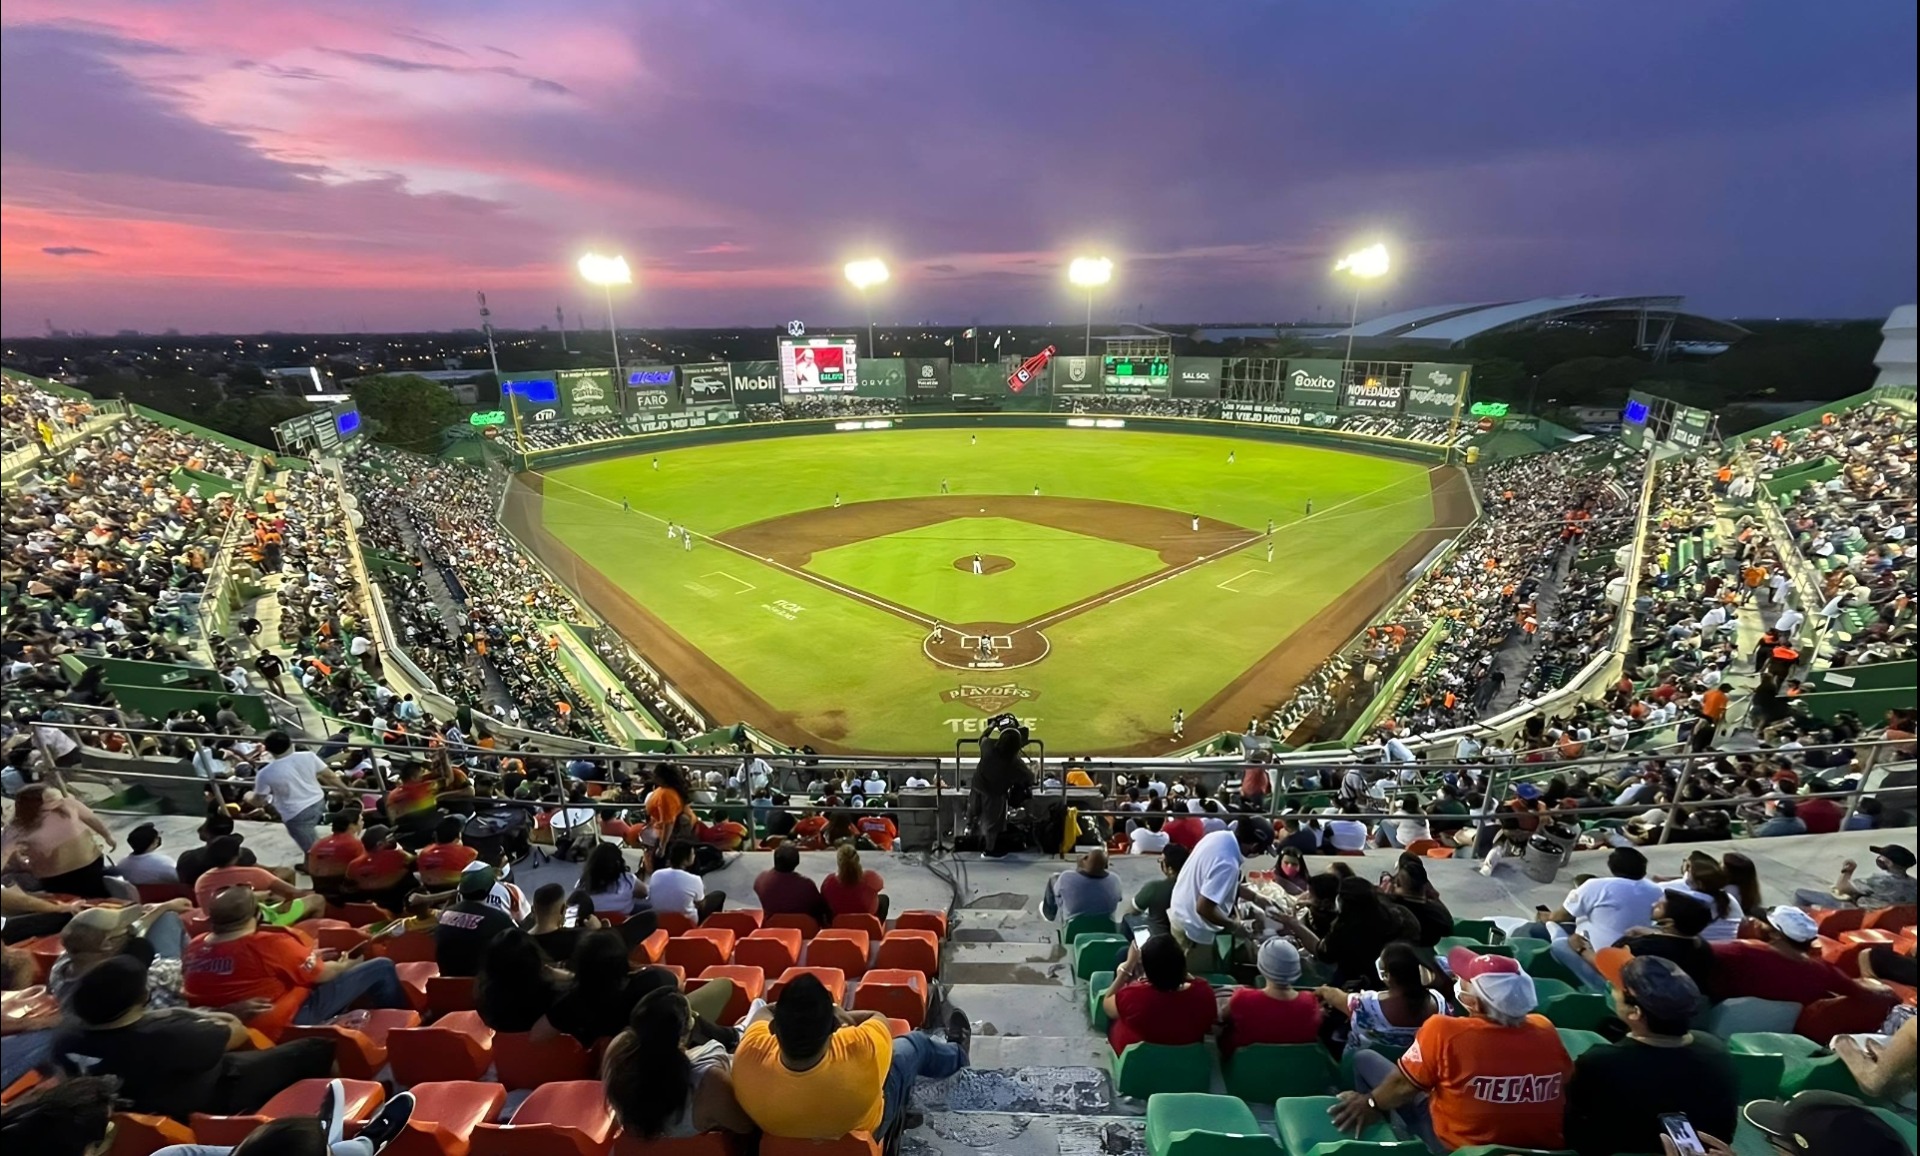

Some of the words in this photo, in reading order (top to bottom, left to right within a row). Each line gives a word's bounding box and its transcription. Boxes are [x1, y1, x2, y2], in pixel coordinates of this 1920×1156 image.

[734, 376, 776, 391] Mobil
[1294, 375, 1336, 389] Boxito
[1347, 385, 1401, 398] NOVEDADES
[637, 394, 668, 406] FARO
[1378, 400, 1397, 408] GAS
[1221, 411, 1234, 419] MI
[1236, 412, 1262, 421] VIEJO
[1263, 413, 1300, 425] MOLINO
[641, 420, 669, 432] VIEJO
[949, 687, 1031, 699] PLAYOFFS
[1463, 1072, 1562, 1104] TECATE
